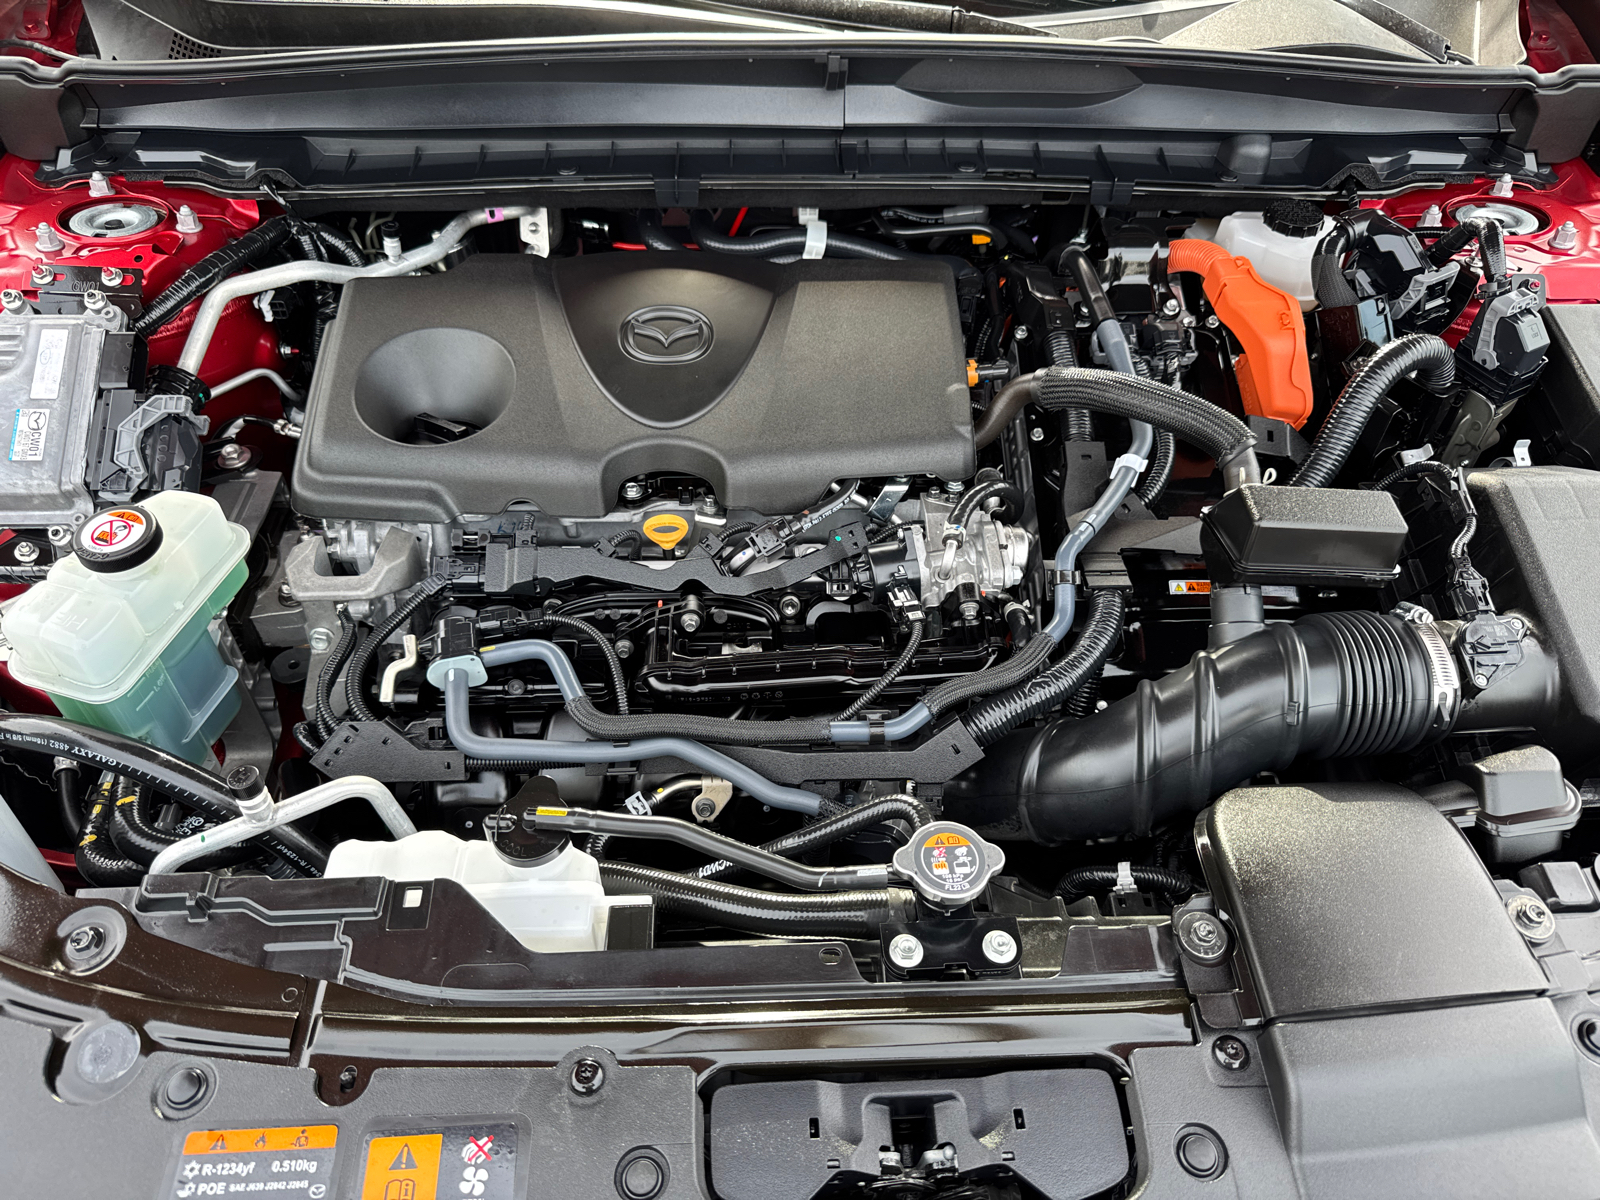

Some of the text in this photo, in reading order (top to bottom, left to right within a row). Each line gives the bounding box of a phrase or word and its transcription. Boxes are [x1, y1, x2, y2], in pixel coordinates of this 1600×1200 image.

[28, 431, 42, 457] CW01
[49, 740, 70, 751] 4882
[71, 746, 117, 766] GALAXY
[276, 844, 308, 867] R-1234yf
[500, 840, 527, 857] COOL
[202, 1159, 318, 1176] R-1234yf 0.510kg
[196, 1182, 227, 1195] POE
[228, 1183, 245, 1192] SAE
